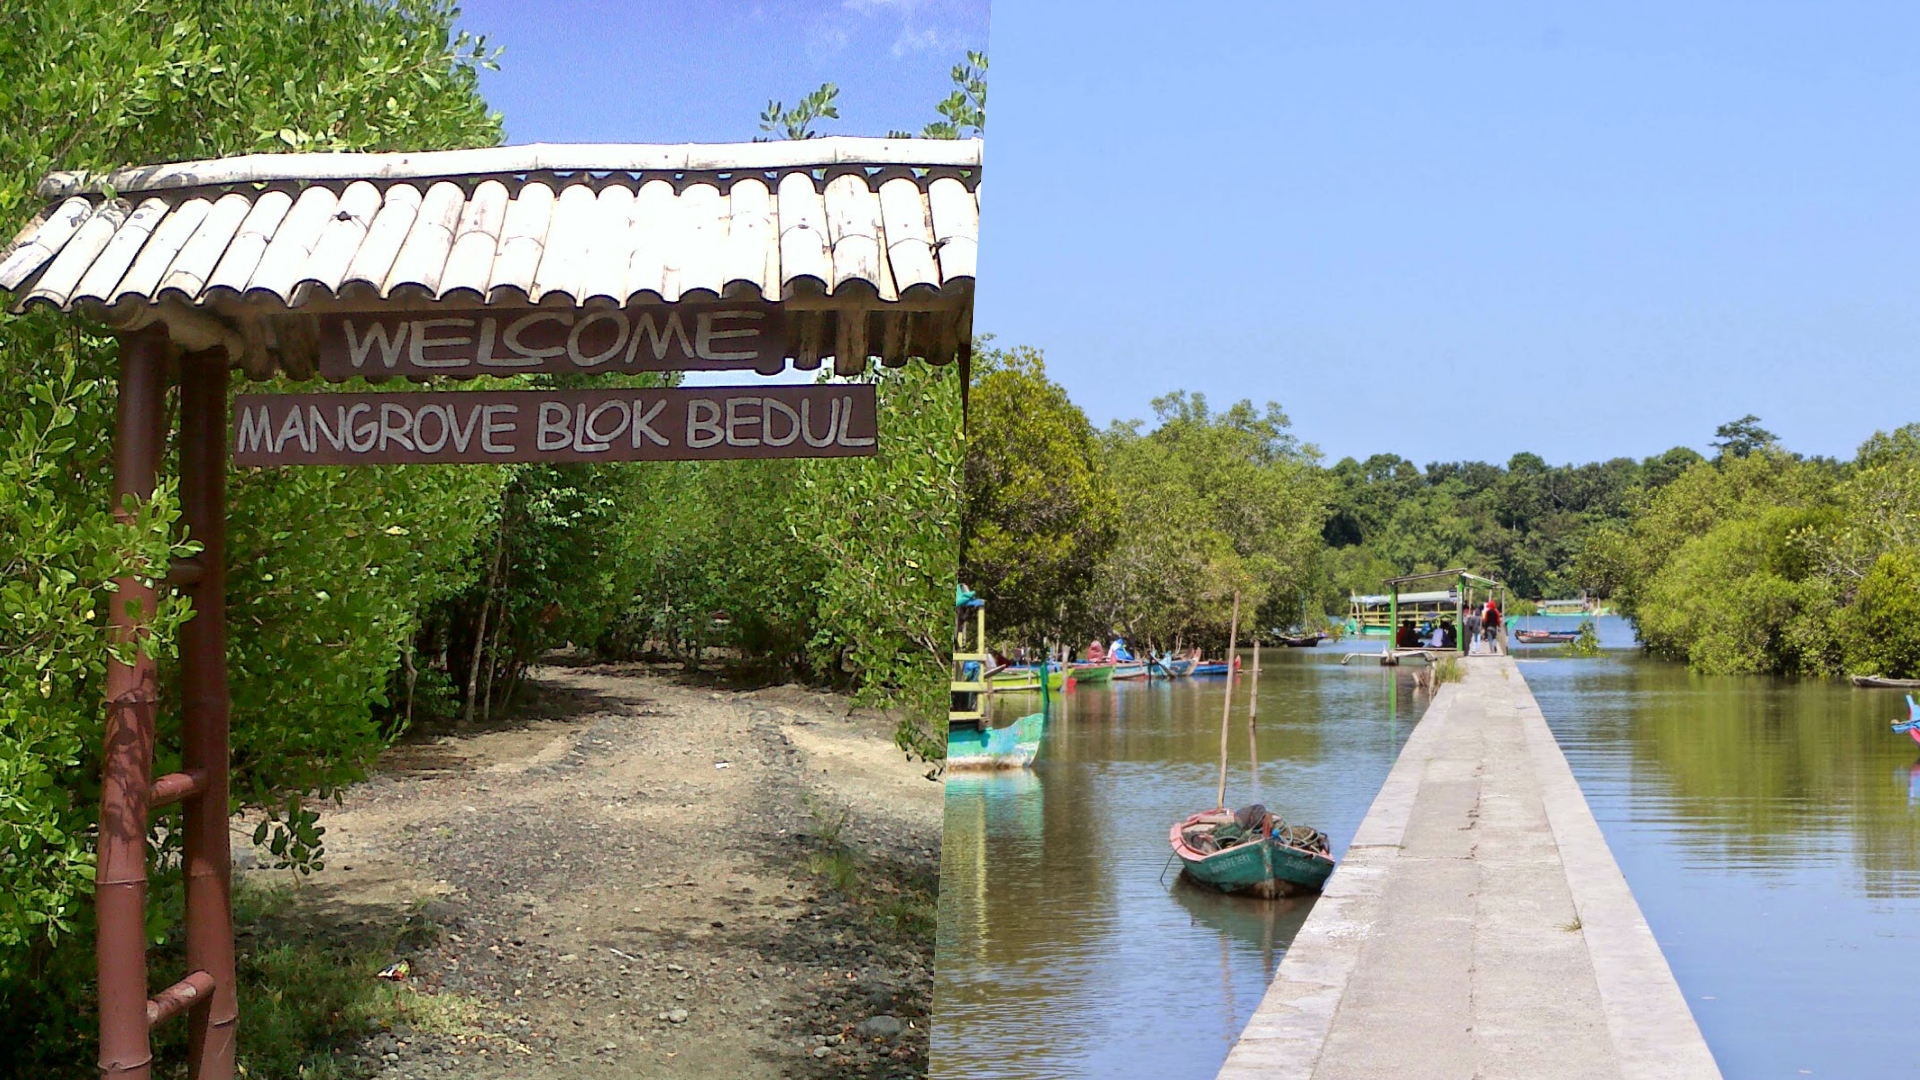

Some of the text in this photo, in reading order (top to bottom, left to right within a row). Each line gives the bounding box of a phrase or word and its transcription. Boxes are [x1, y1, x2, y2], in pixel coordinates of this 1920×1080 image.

[343, 309, 765, 369] WELCOME
[238, 395, 876, 454] MANGROVE BLOK BEDUL
